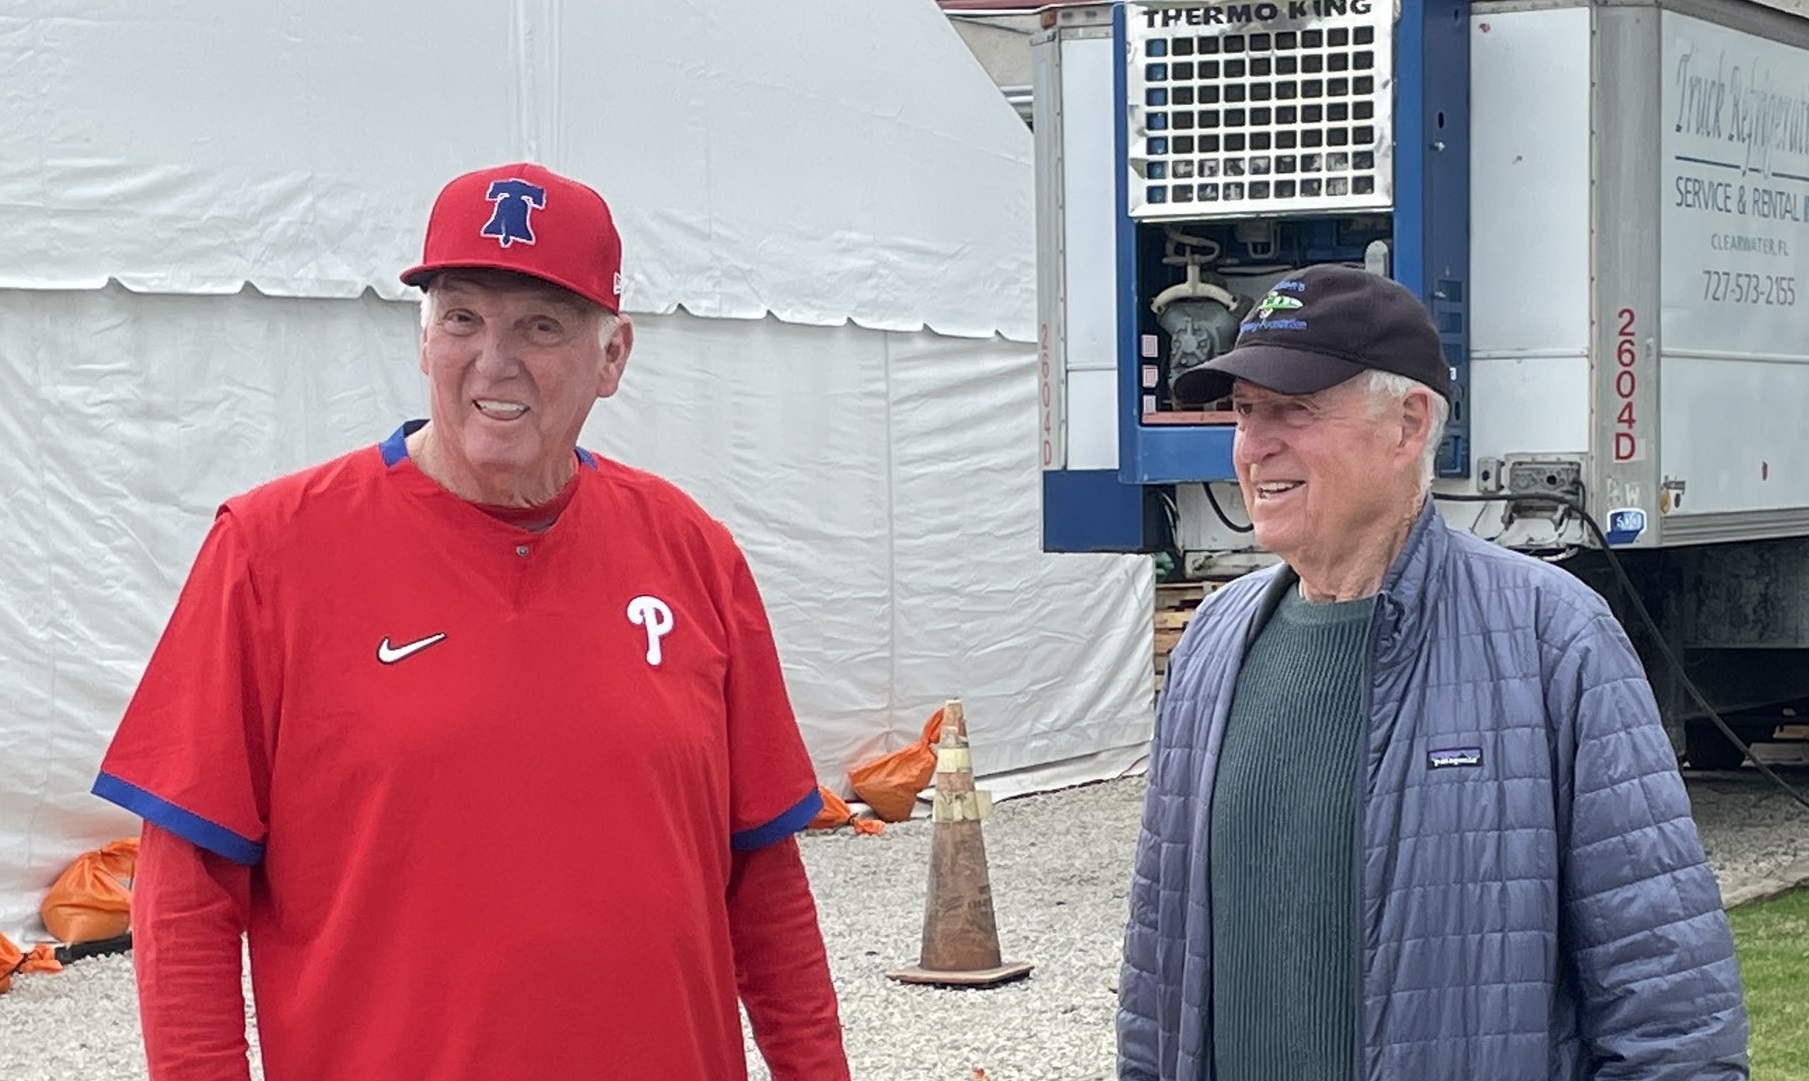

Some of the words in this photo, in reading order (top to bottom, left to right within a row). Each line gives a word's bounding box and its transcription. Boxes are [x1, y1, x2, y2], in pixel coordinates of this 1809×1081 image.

[1143, 3, 1278, 28] THERMO
[1288, 0, 1372, 19] KING
[1675, 46, 1726, 139] Truck
[1675, 176, 1732, 213] SERVICE
[1737, 185, 1747, 215] &
[1752, 187, 1800, 222] RENTAL
[1777, 239, 1789, 257] FL
[1702, 269, 1796, 306] 727-573-2155
[1615, 308, 1636, 461] 2604D
